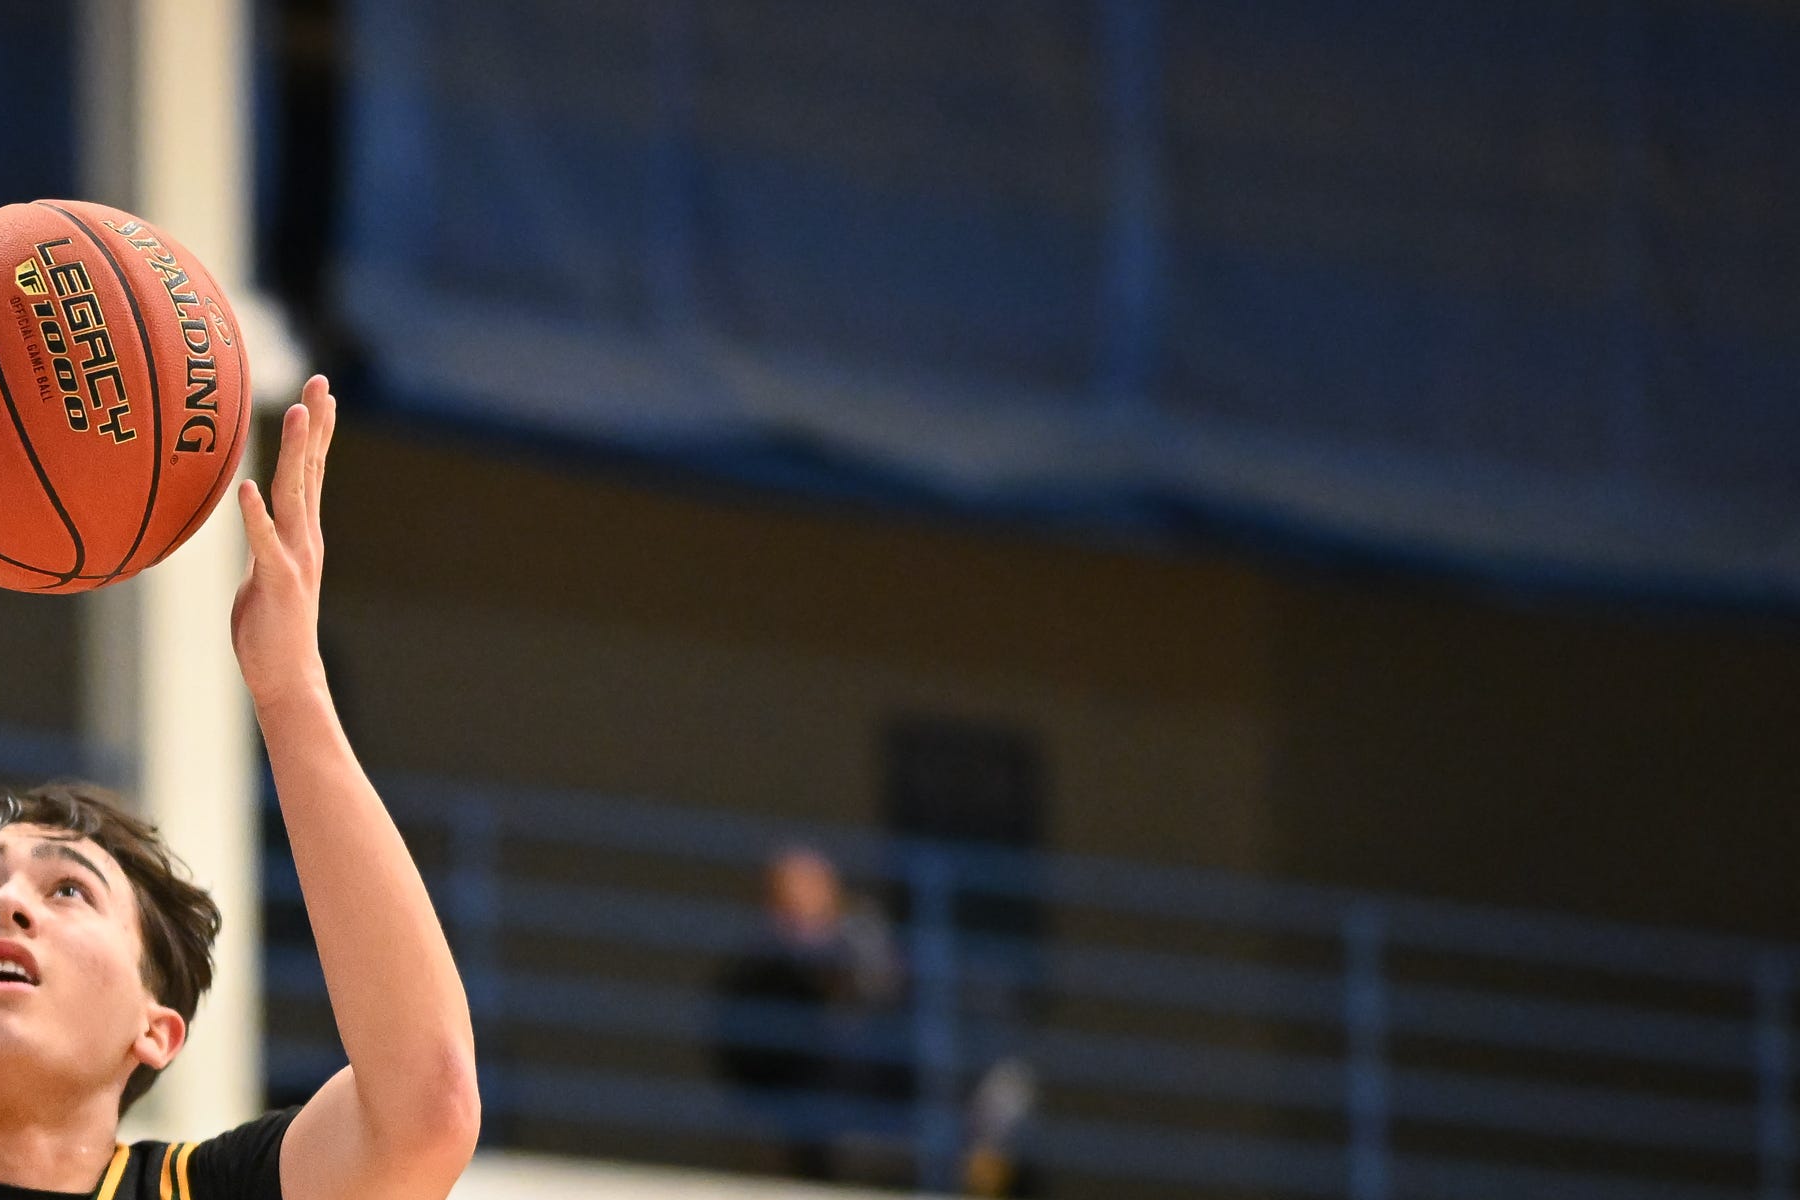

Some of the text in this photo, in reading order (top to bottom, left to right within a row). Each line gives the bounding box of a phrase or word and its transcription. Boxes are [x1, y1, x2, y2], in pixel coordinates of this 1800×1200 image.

[10, 296, 55, 402] OFFICIAL GAME BALL
[16, 258, 89, 432] TF 1000
[35, 238, 137, 445] LEGACY
[102, 220, 218, 454] SPALDING
